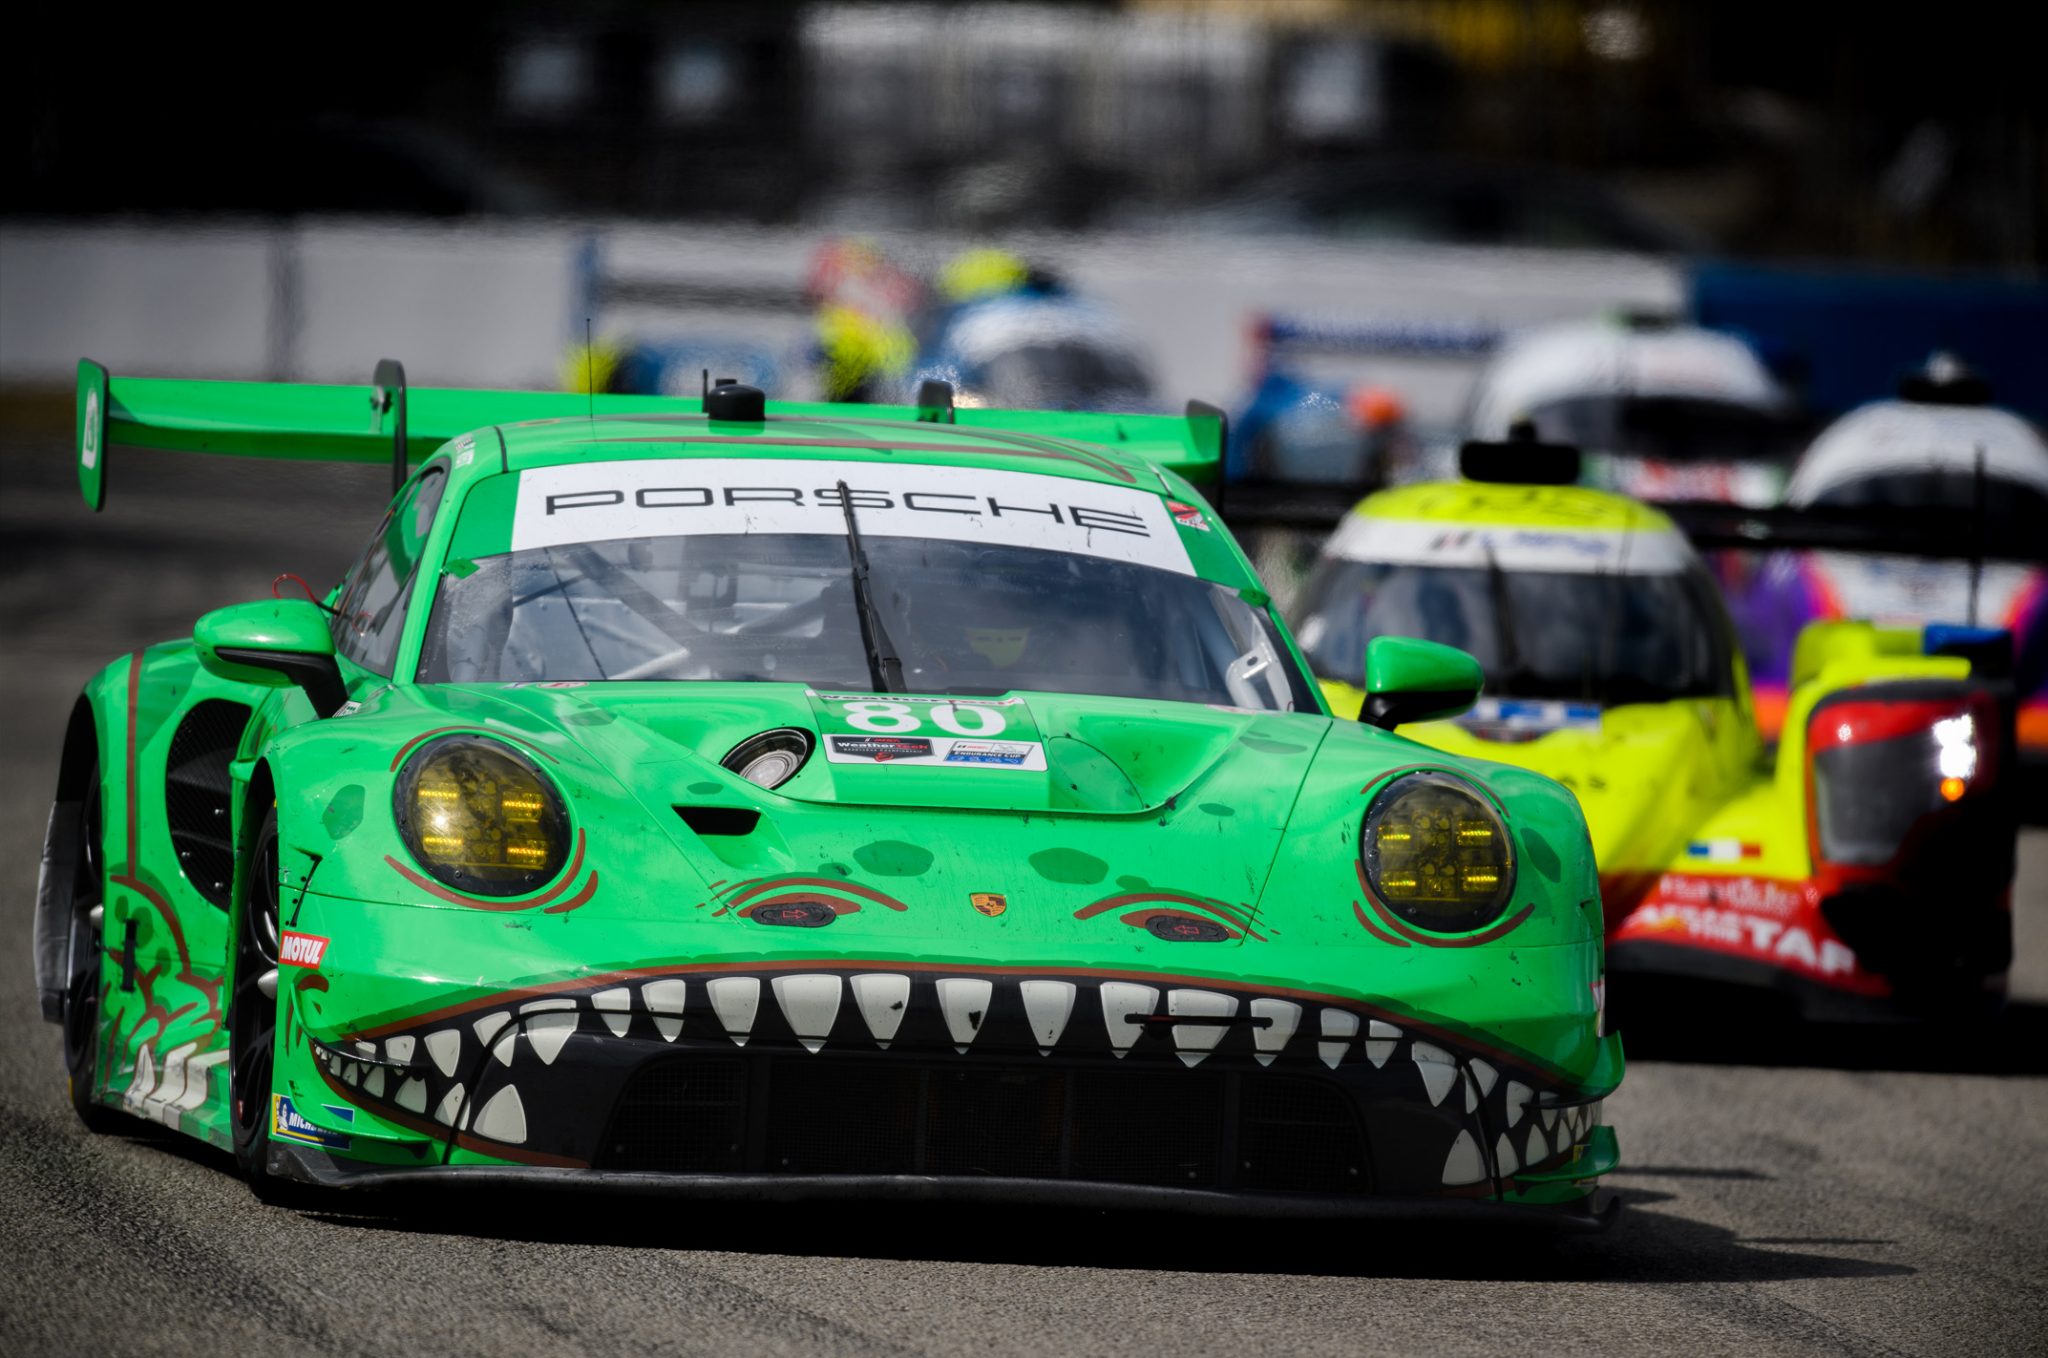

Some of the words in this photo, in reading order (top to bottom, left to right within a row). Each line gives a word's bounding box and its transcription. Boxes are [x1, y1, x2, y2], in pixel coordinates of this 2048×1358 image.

[546, 487, 1151, 537] PORSCHE
[842, 701, 1007, 737] 80
[280, 935, 324, 965] MOTUL
